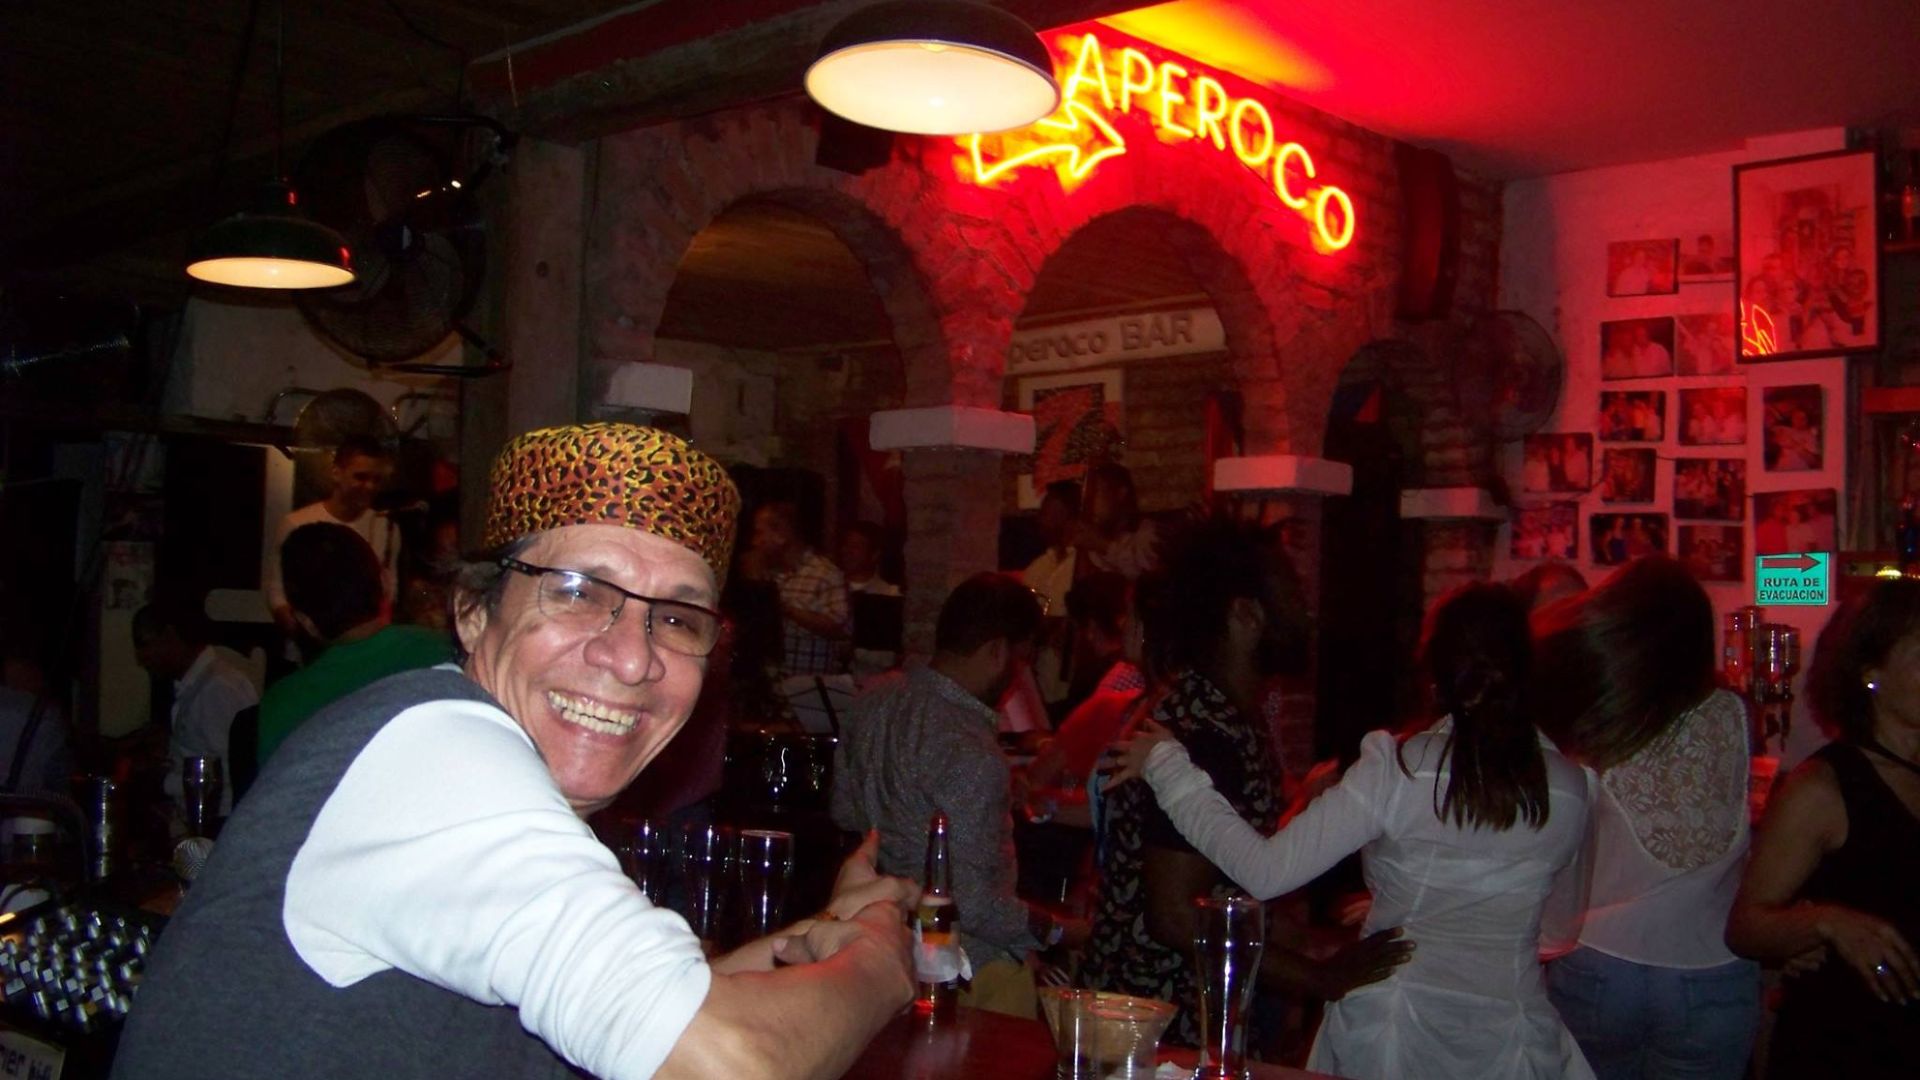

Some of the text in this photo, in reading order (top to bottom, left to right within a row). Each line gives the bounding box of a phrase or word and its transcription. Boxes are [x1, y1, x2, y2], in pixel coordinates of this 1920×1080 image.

[1064, 32, 1355, 250] APEROCO
[1119, 312, 1194, 350] BAR
[1763, 577, 1820, 587] RUTA DE
[1760, 590, 1824, 600] EVACUACION
